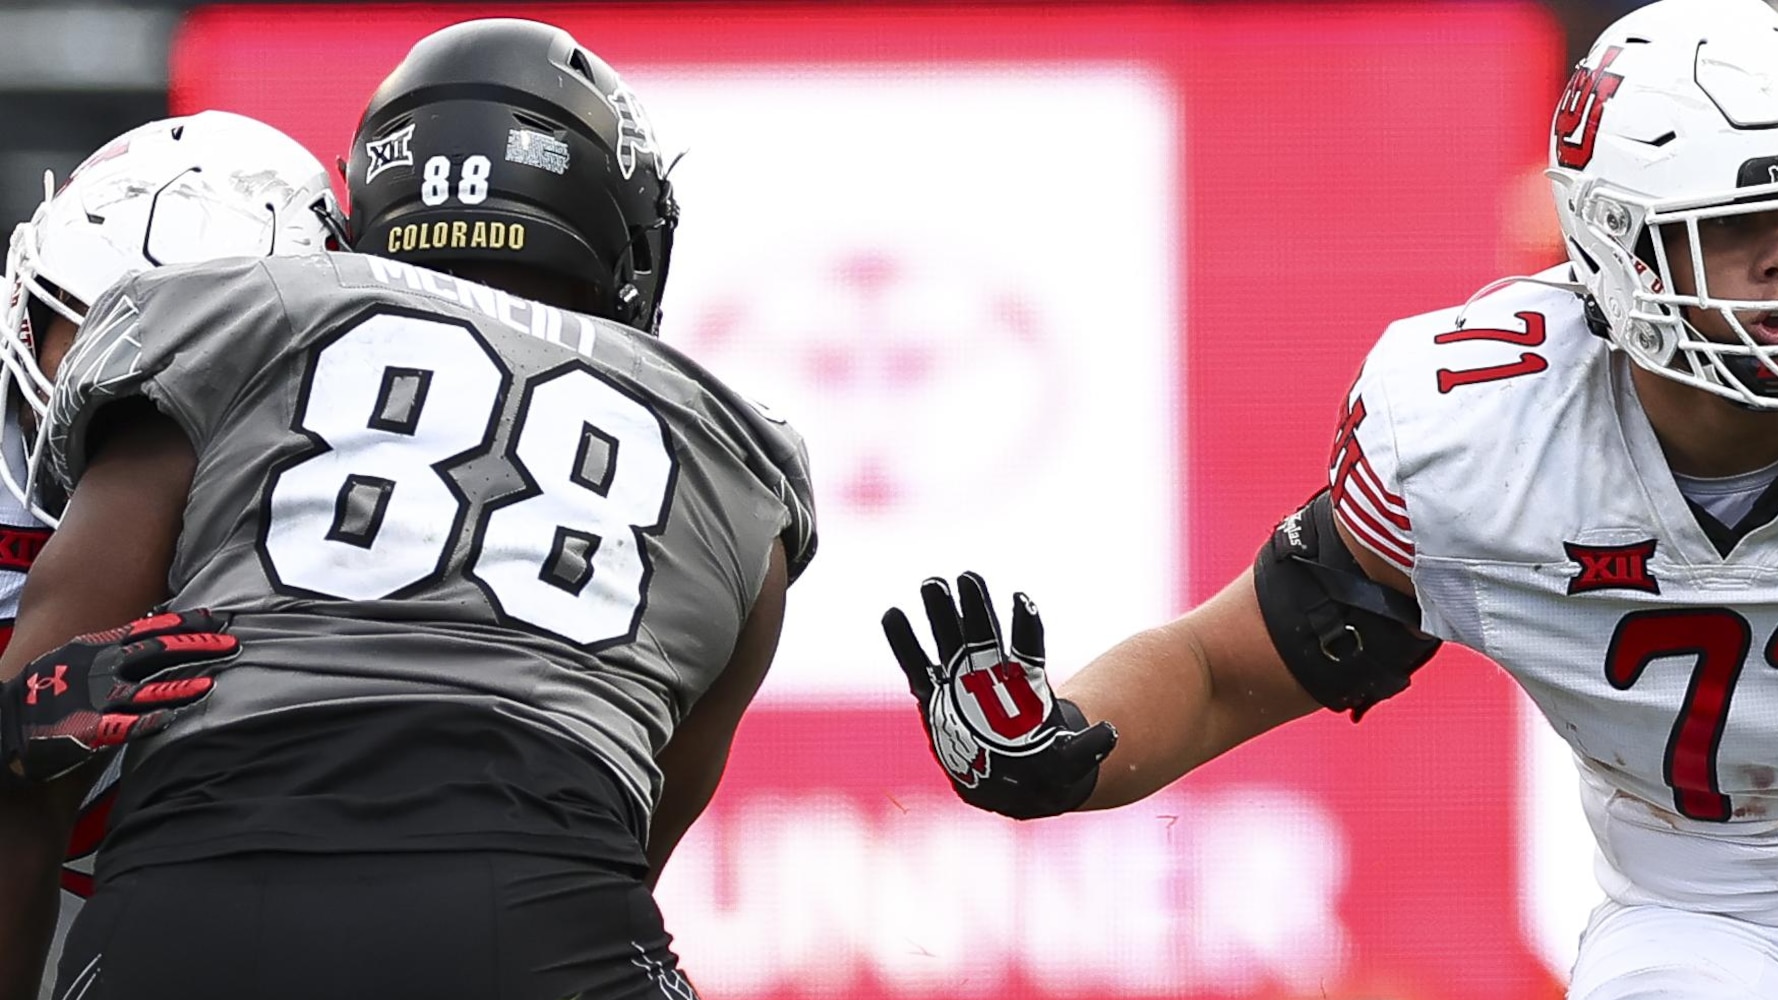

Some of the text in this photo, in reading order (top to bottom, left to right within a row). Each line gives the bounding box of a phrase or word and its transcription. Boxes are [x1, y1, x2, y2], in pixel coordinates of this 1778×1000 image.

[421, 155, 491, 206] 88
[388, 221, 525, 252] COLORADO
[1434, 310, 1549, 394] 71
[256, 303, 678, 648] 88
[1573, 548, 1650, 588] XII
